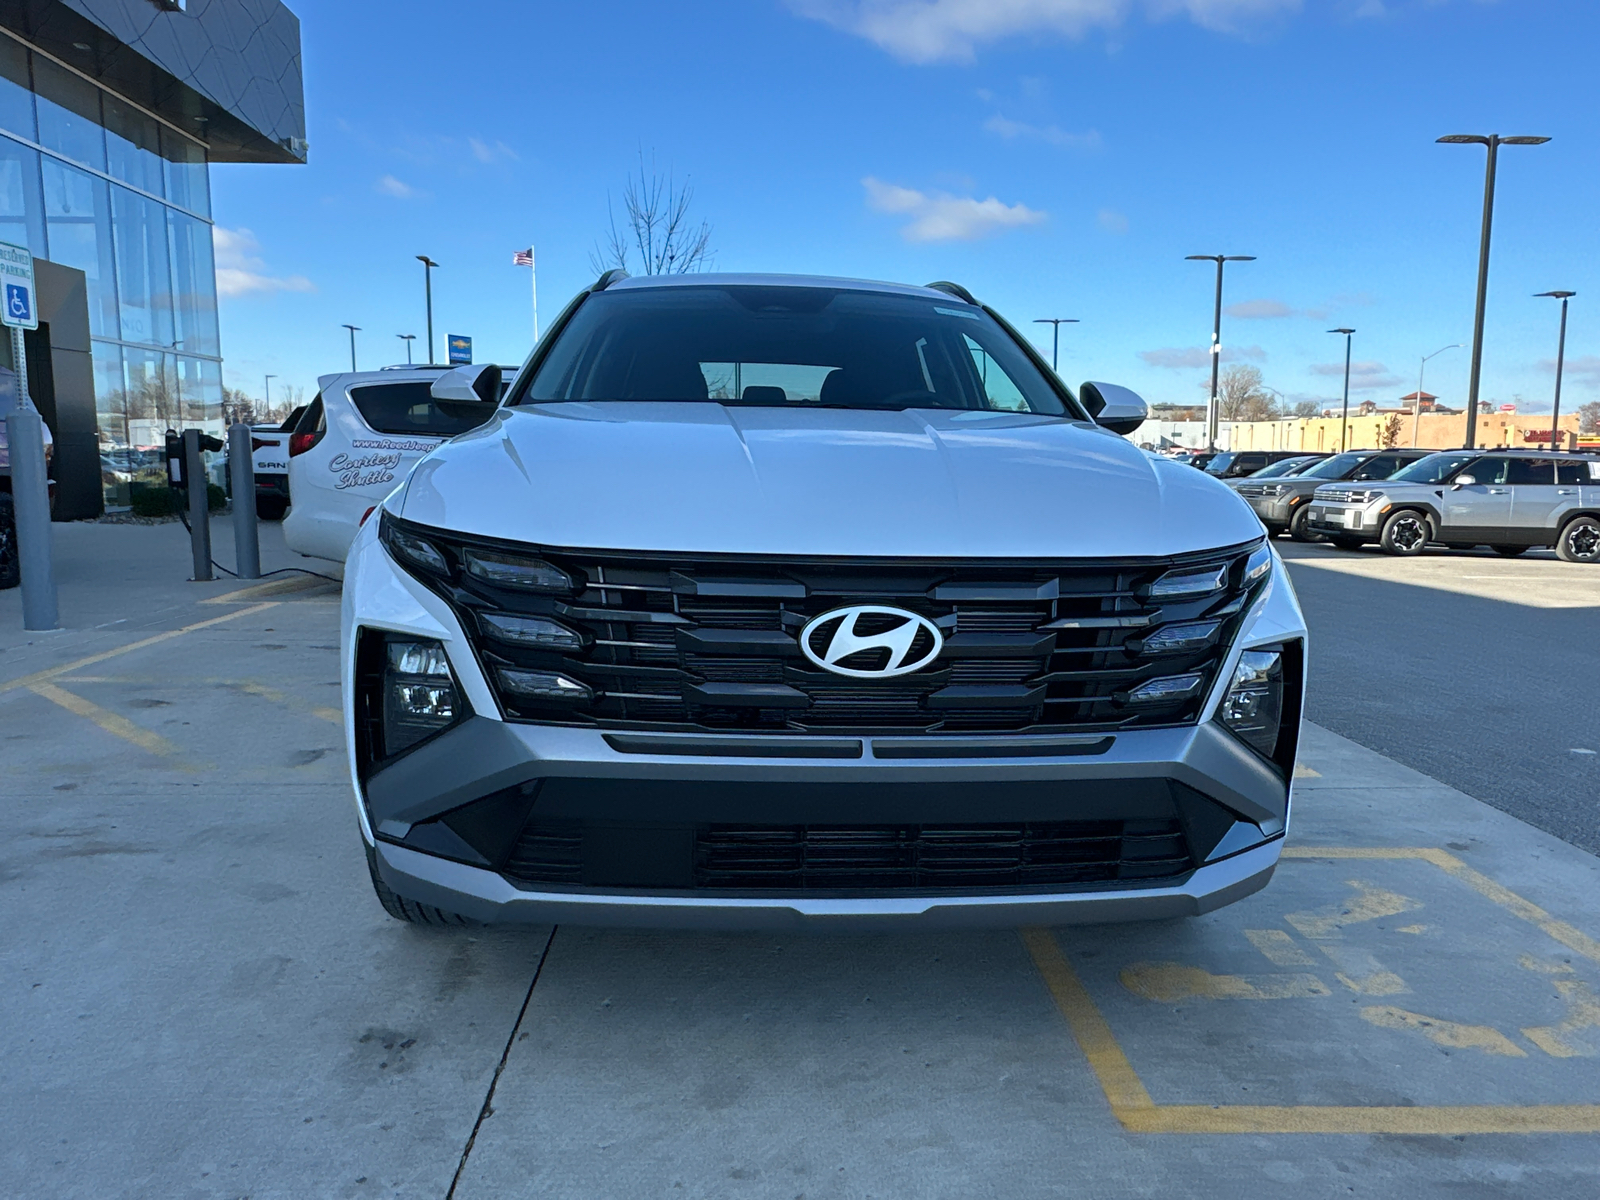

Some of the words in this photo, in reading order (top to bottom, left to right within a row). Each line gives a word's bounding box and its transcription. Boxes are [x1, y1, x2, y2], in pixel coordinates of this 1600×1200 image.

[0, 263, 30, 279] PARKING
[328, 453, 402, 472] Courtesy
[334, 468, 394, 489] Shuttle
